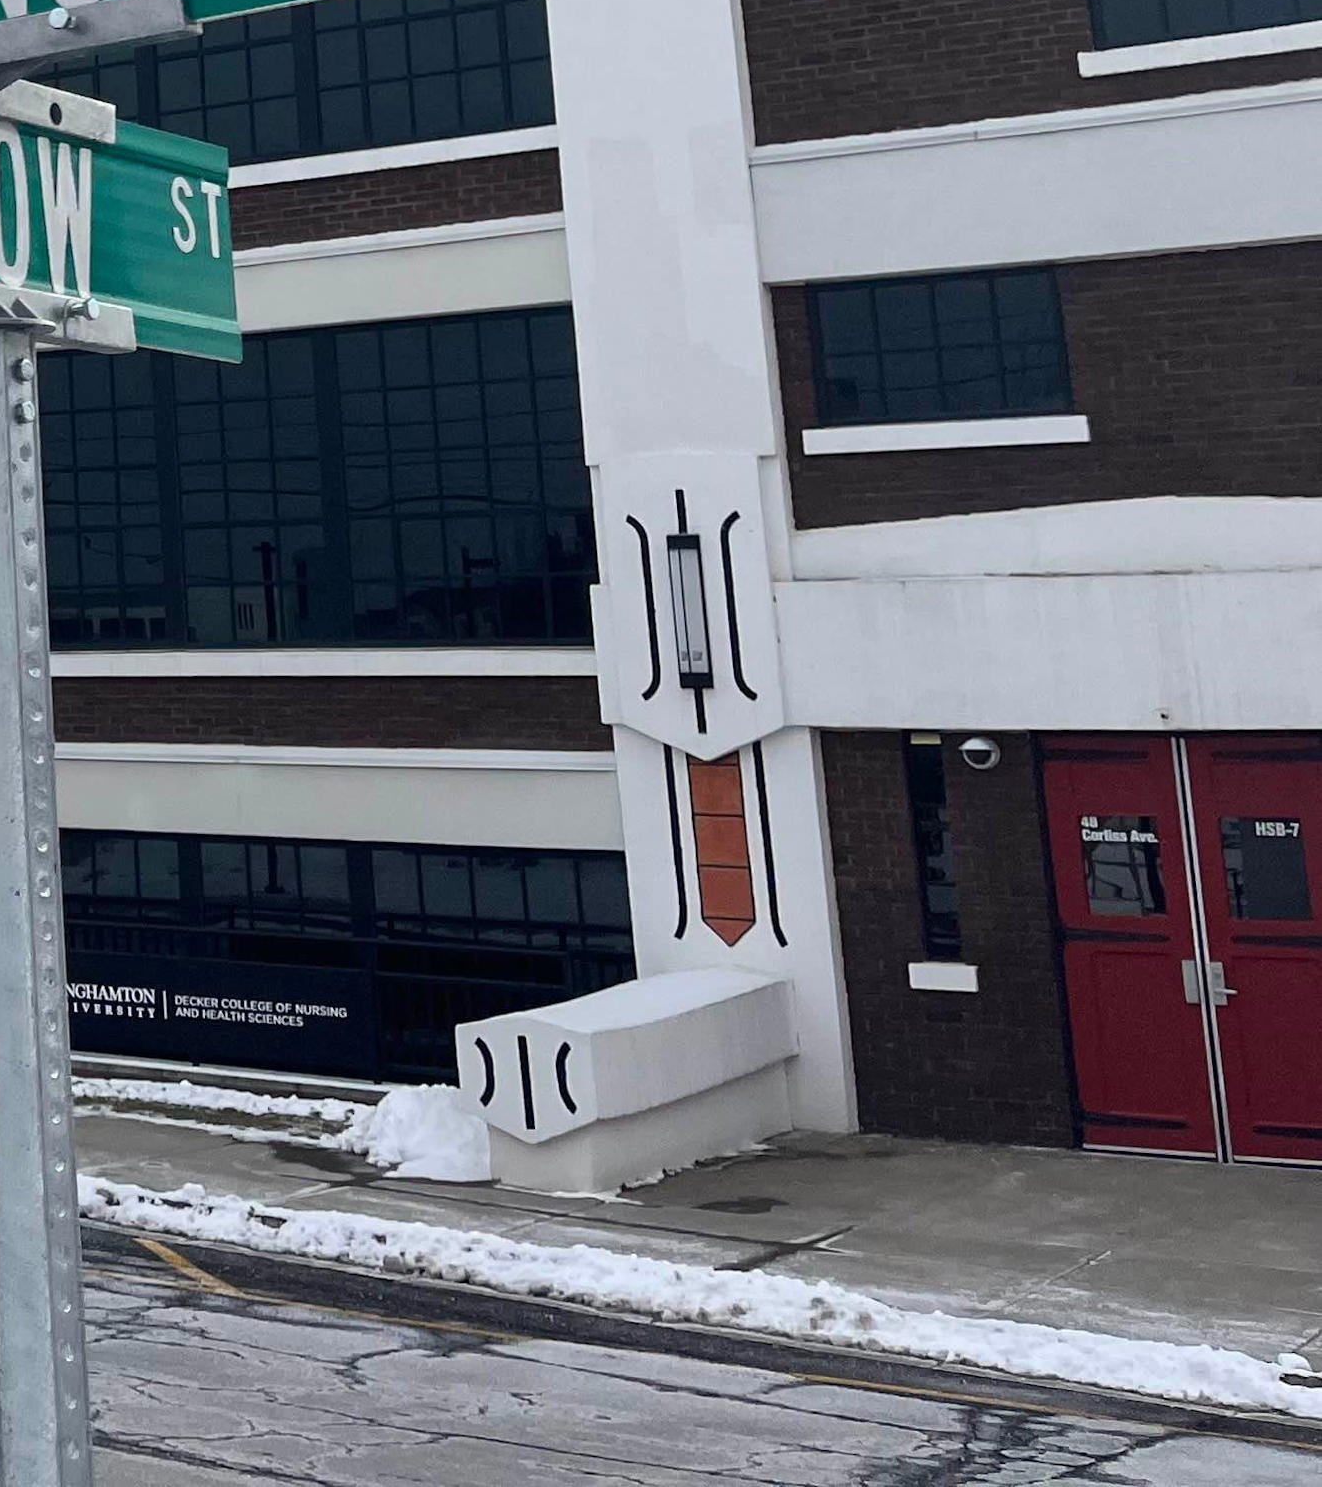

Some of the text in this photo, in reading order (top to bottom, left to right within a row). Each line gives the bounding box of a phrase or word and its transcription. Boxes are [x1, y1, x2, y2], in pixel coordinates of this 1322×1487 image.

[171, 175, 224, 260] ST
[1254, 820, 1300, 838] HSB-7
[64, 982, 156, 1005] NGHAMTON
[72, 1001, 156, 1019] IVERSITY
[174, 994, 348, 1019] DECKER COLLEGE OF NURSING
[175, 1006, 304, 1028] AND HEALTH SCIENCES
